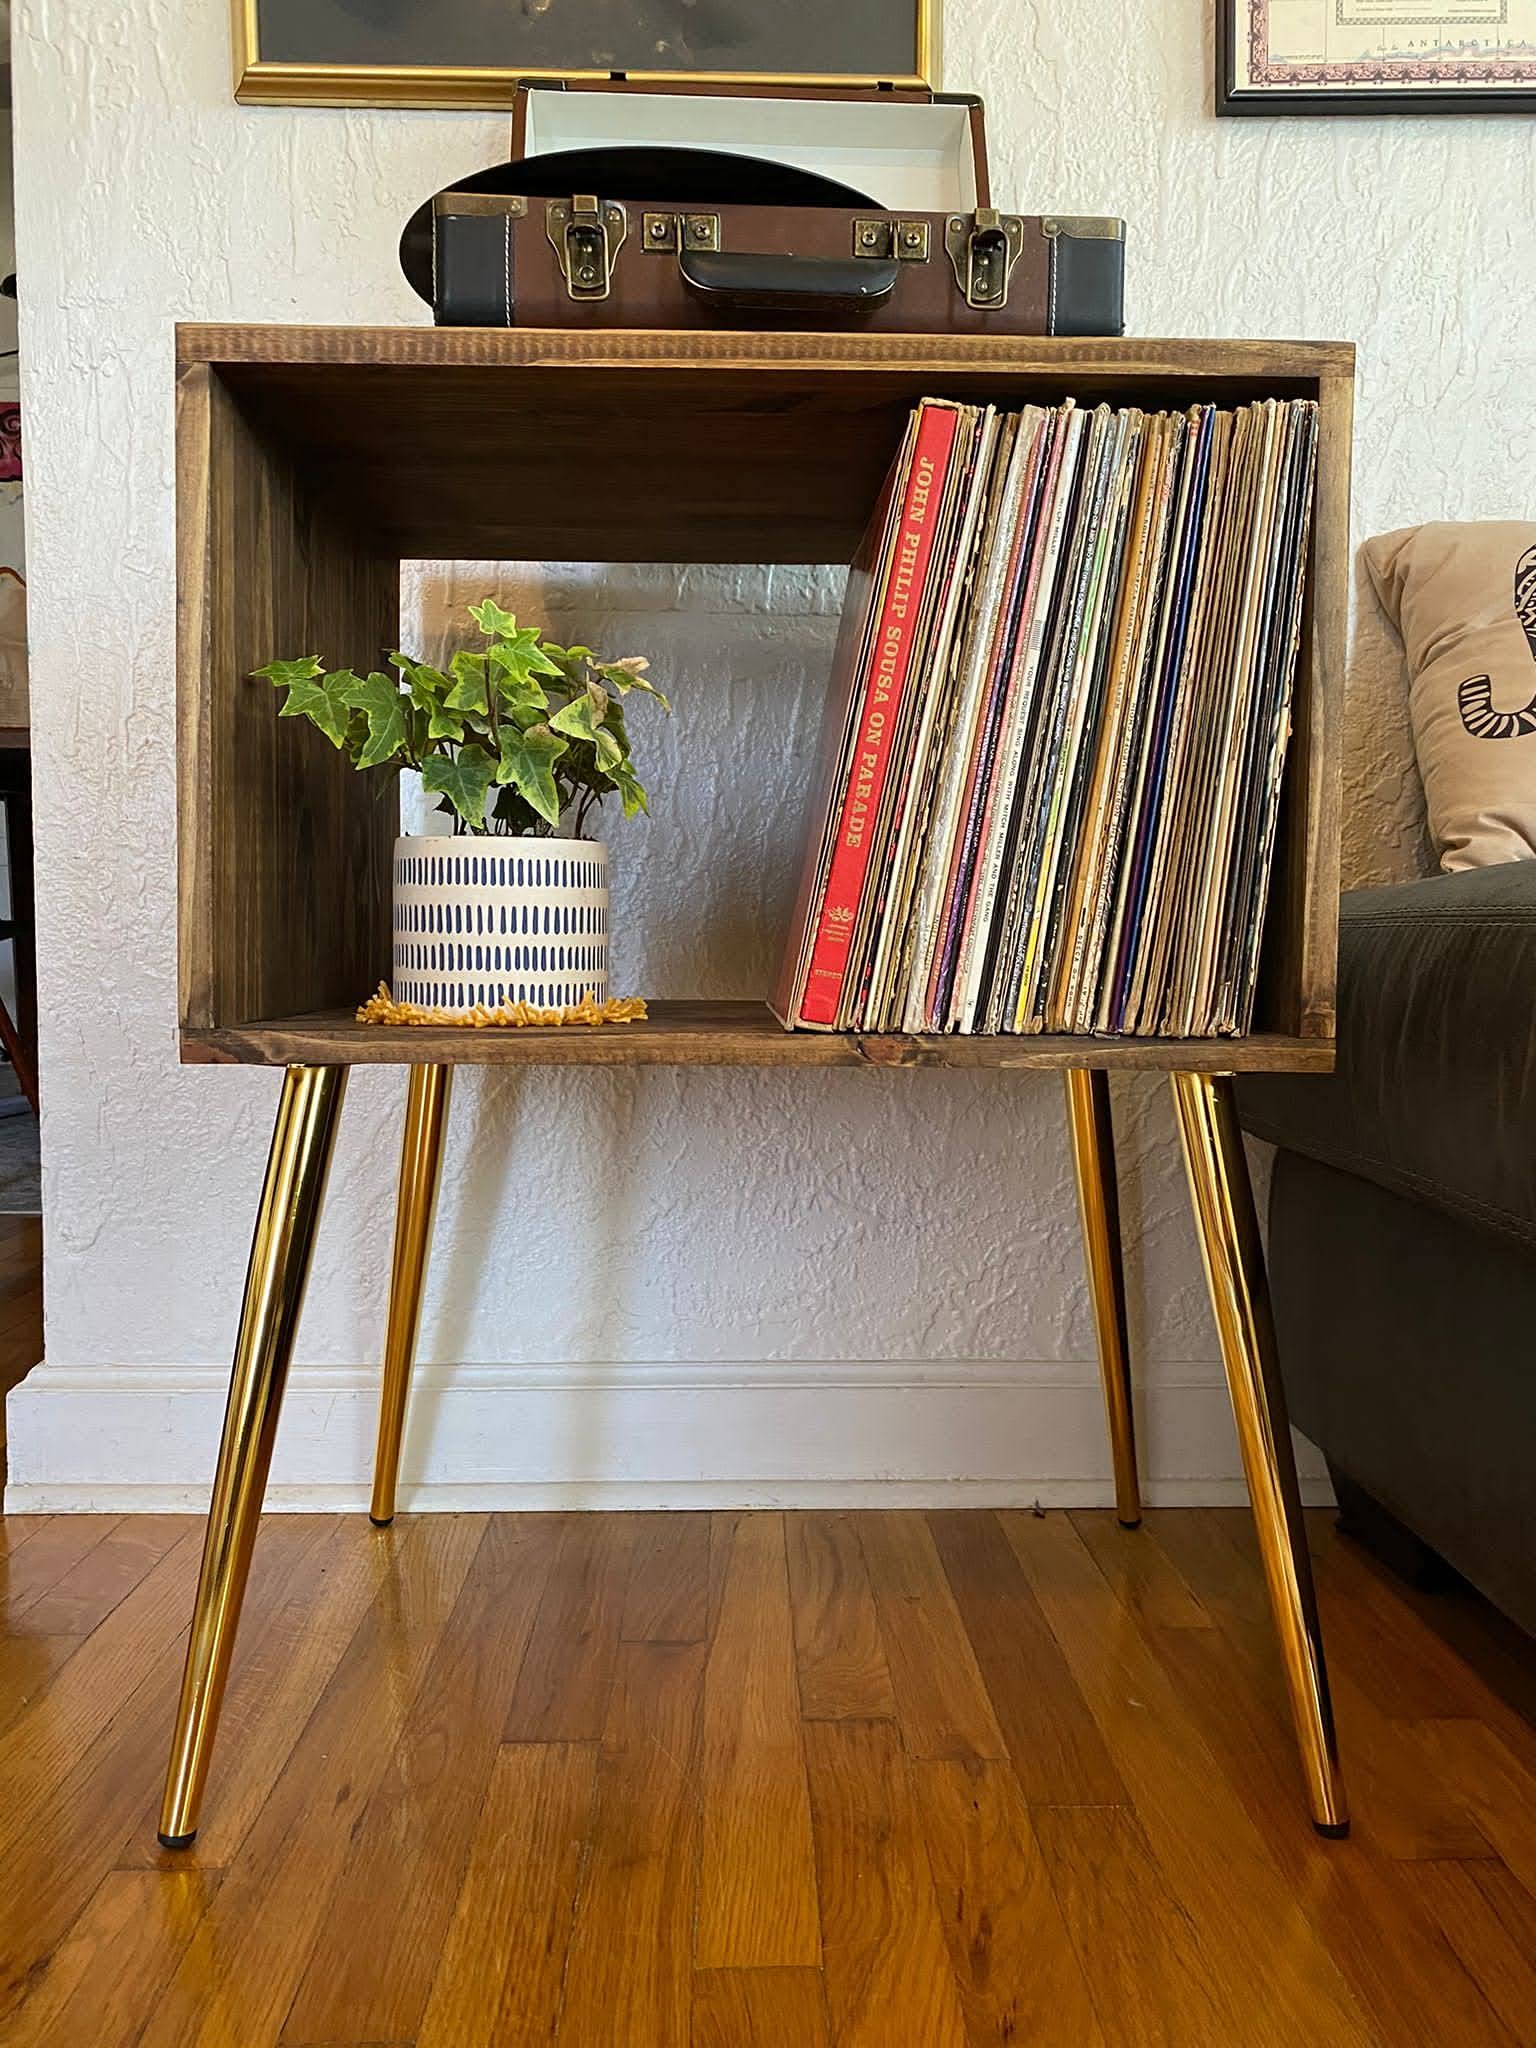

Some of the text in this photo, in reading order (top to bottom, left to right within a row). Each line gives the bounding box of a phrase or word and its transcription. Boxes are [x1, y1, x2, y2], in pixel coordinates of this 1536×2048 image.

[844, 455, 935, 849] JOHN PHILIP SOUSA ON PARADE
[1024, 664, 1034, 689] YOUR
[1017, 689, 1030, 725] REQUEST
[1014, 727, 1024, 747] SING
[1008, 749, 1020, 777] ALONG
[1004, 779, 1014, 801] WITH
[999, 803, 1010, 829] MITCH
[993, 831, 1005, 860] MILLER
[989, 862, 999, 880] AND
[986, 882, 995, 898] THE
[981, 900, 992, 923] GANG
